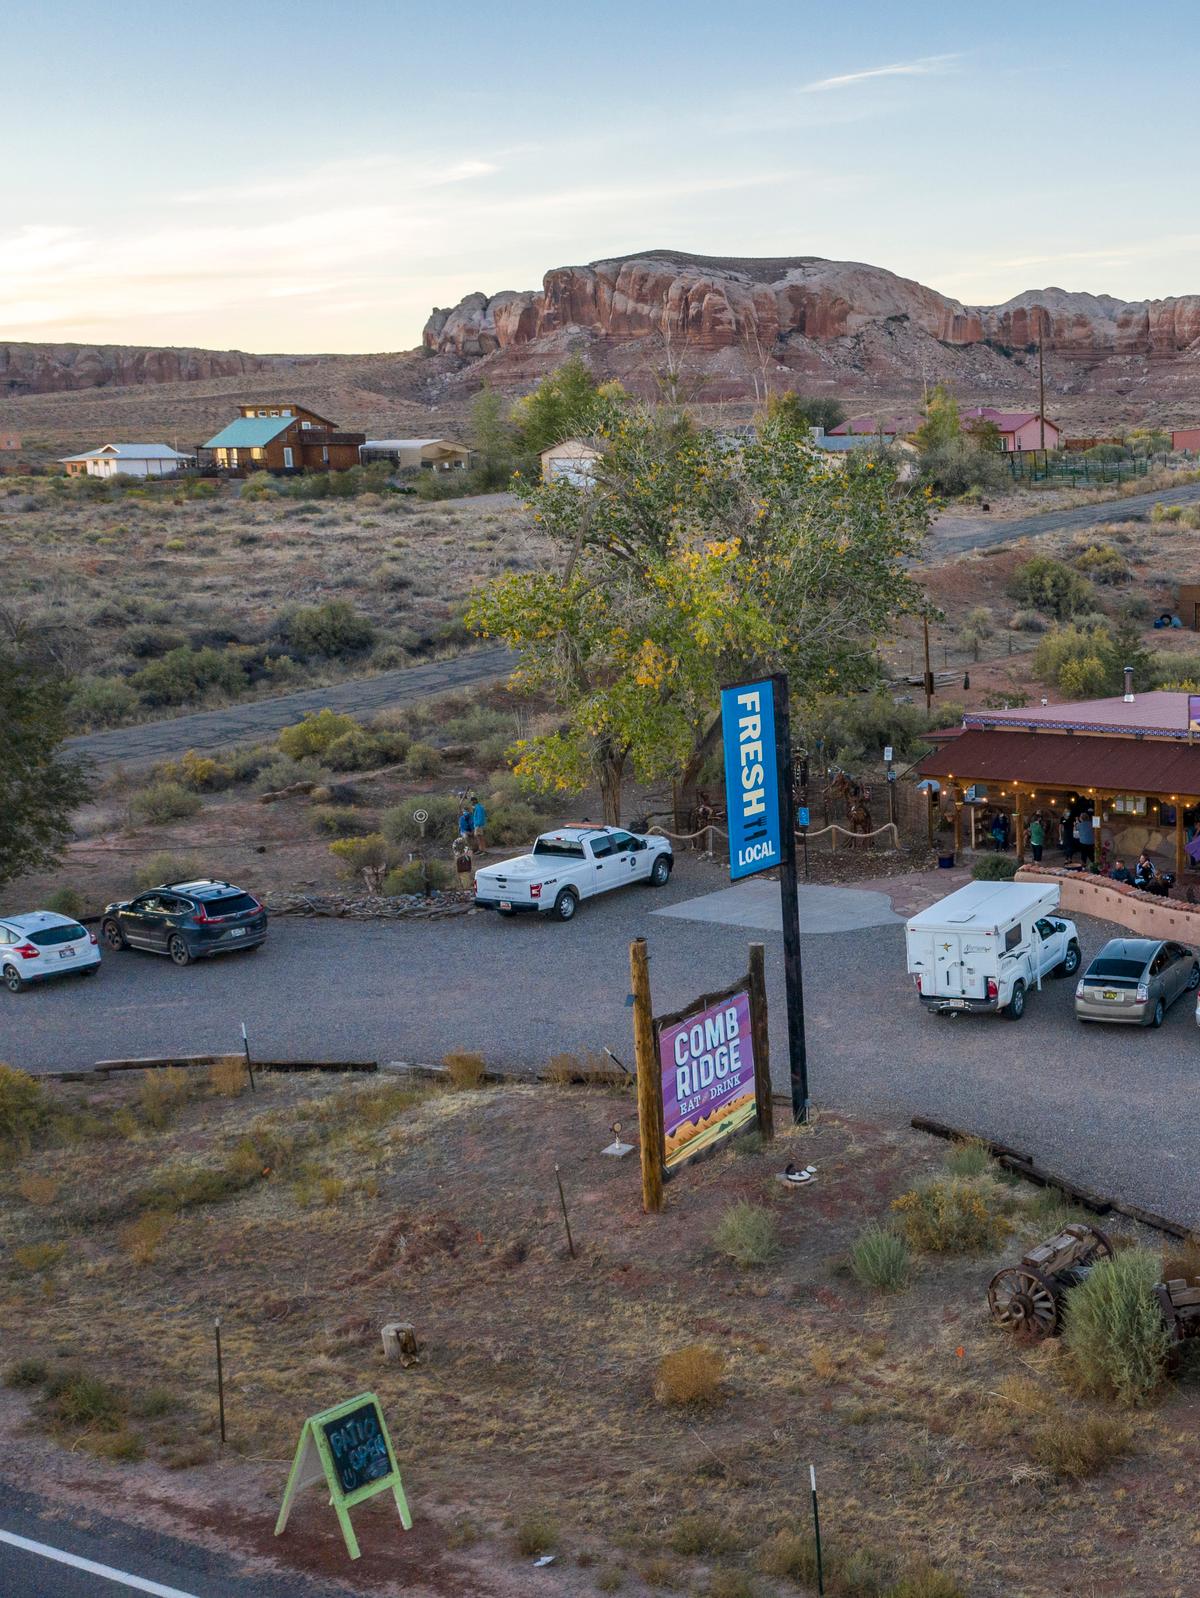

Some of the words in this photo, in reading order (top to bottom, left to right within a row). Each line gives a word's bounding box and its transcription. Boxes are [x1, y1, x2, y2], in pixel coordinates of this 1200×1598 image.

[737, 691, 766, 817] FRESH
[738, 840, 776, 866] LOCAL
[674, 1006, 740, 1067] COMB
[676, 1038, 742, 1102] RIDGE
[680, 1095, 701, 1116] EAT
[710, 1073, 741, 1100] DRINK
